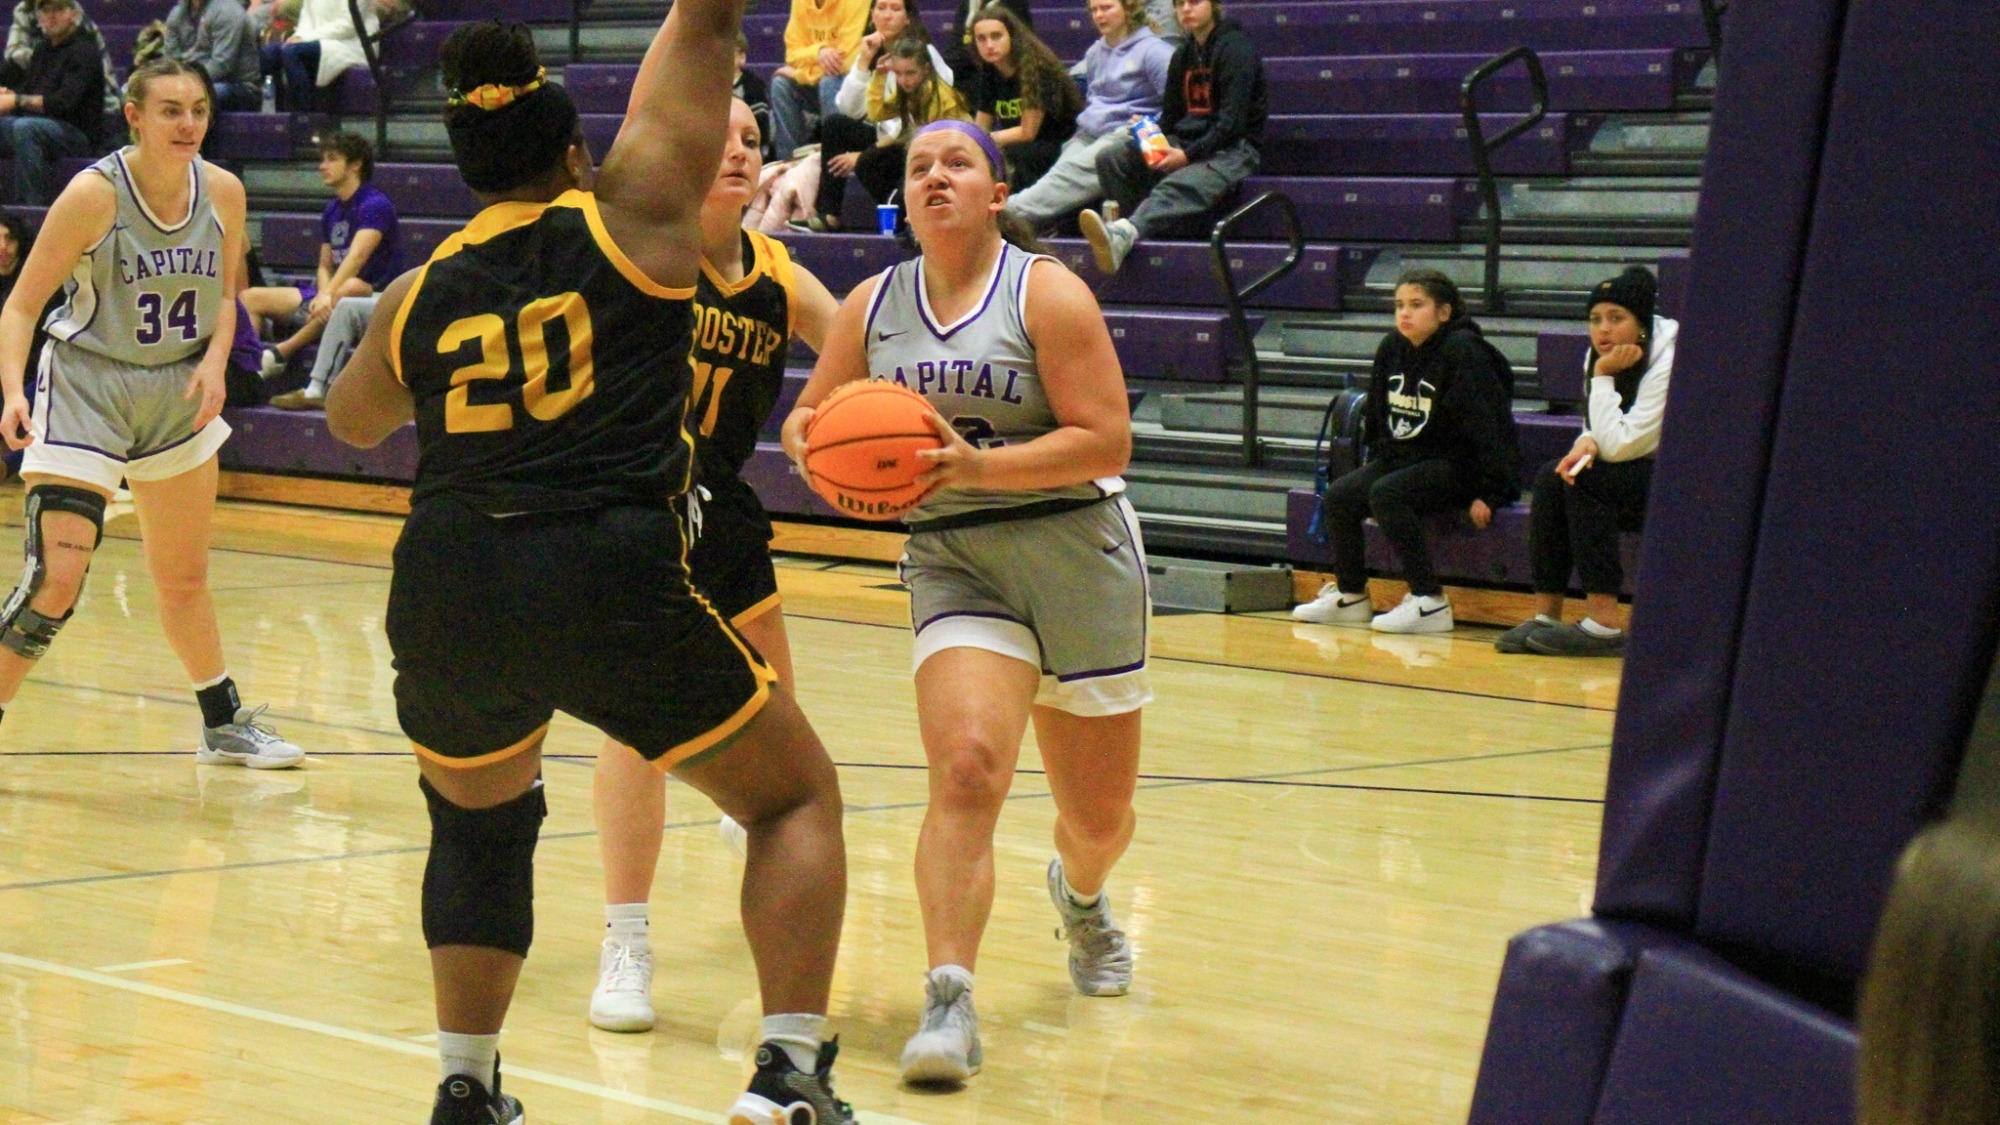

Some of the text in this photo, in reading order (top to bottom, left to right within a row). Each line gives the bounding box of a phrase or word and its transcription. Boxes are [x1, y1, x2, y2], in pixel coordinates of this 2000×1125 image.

[119, 248, 217, 285] CAPITAL
[135, 289, 198, 345] 34
[692, 302, 782, 366] OOSTER
[436, 291, 596, 434] 20
[878, 359, 1023, 405] APITAL
[951, 415, 1007, 450] 2
